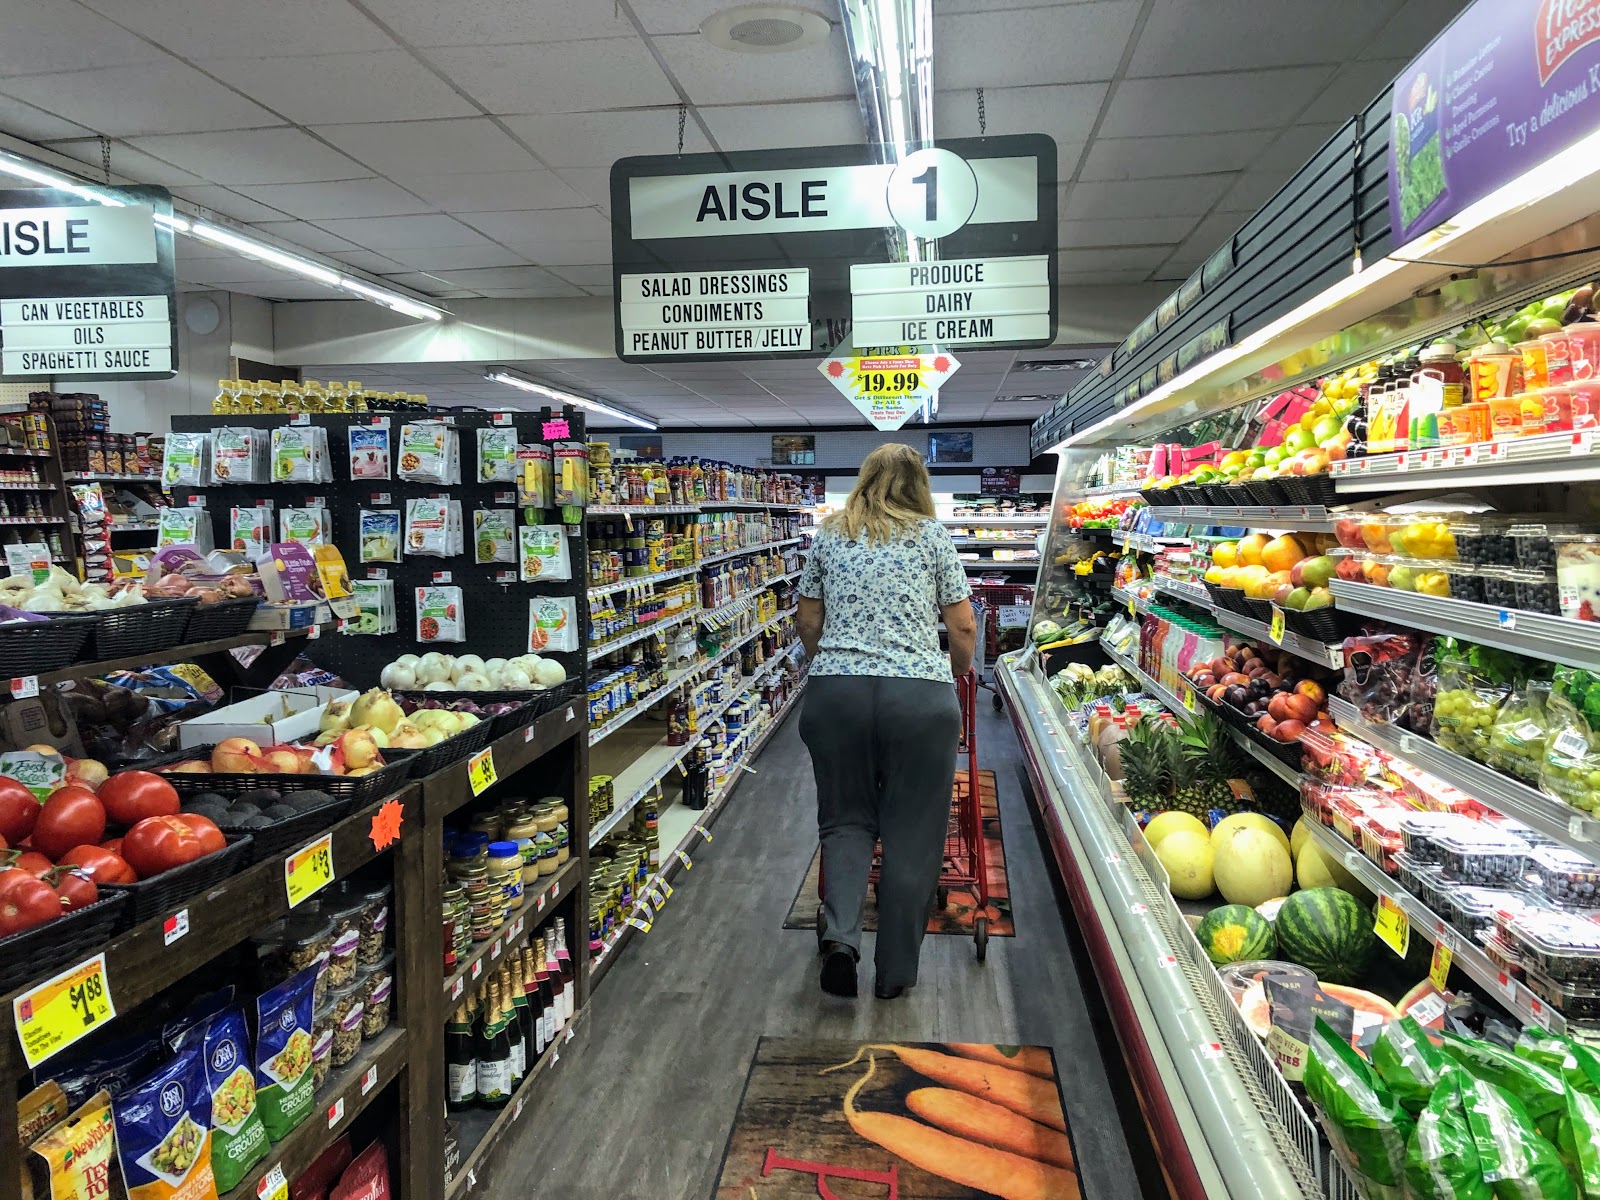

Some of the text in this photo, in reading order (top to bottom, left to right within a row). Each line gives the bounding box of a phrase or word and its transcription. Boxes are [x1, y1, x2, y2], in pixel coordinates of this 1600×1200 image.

[1506, 122, 1527, 147] Try
[1530, 116, 1538, 132] a
[1540, 79, 1588, 127] delicious
[696, 166, 938, 222] AISLE 1
[0, 219, 91, 255] ISLE
[641, 274, 788, 297] SALAD DRESSINGS
[910, 264, 984, 286] PRODUCE
[22, 301, 144, 321] CAN VEGETABLES
[662, 302, 763, 324] CONDIMENTS
[926, 292, 972, 313] DAIRY
[74, 327, 104, 345] OILS
[633, 328, 803, 351] PEANUT BUTTER/JELLY
[902, 319, 993, 341] ICE CREAM
[22, 350, 150, 369] SPAGHETTI SAUCE
[857, 373, 919, 392] $19.99
[1283, 1038, 1303, 1055] VIEW
[73, 1142, 93, 1159] New
